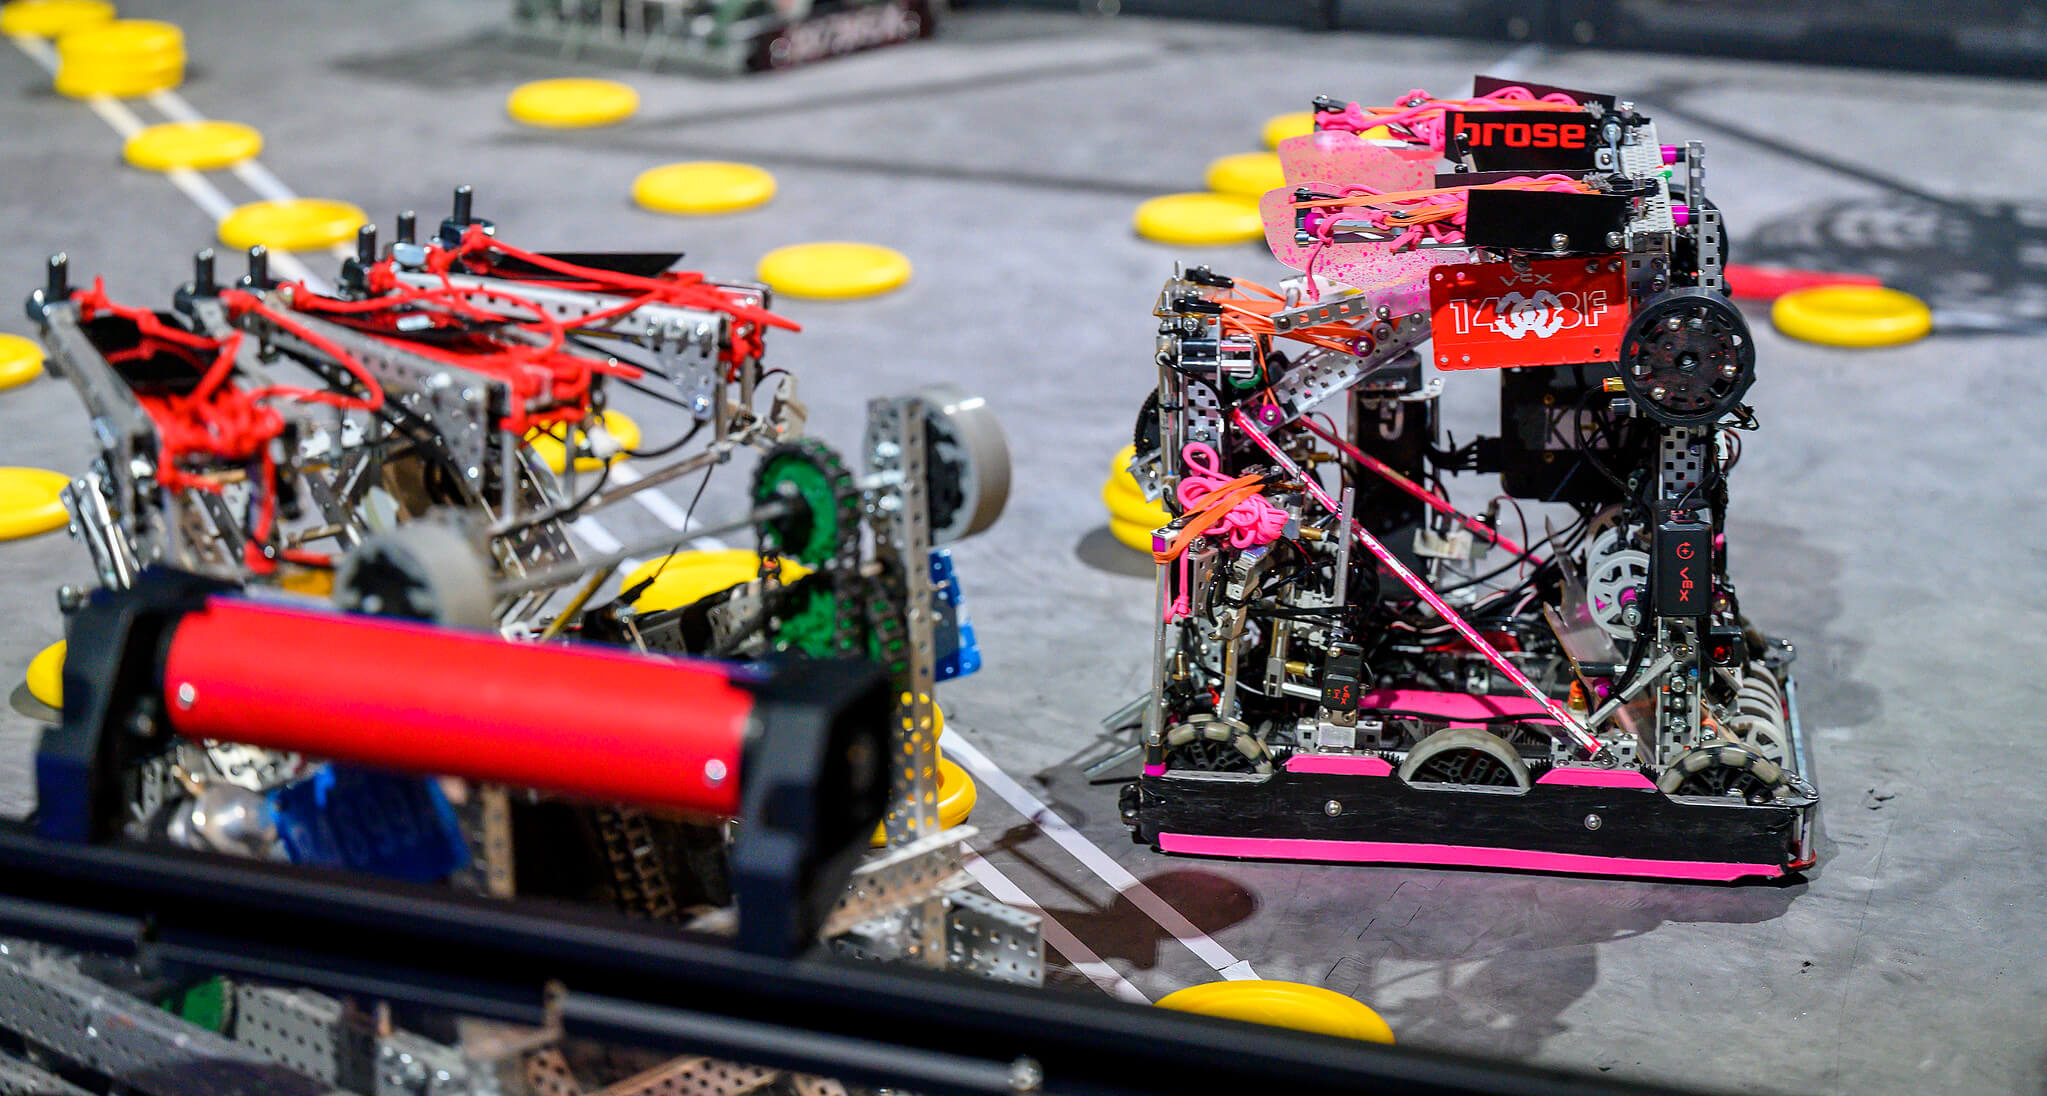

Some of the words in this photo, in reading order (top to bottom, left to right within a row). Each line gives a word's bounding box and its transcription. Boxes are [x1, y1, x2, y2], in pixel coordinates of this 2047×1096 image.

[1454, 113, 1586, 149] brose
[1500, 268, 1553, 287] VEX
[1680, 567, 1694, 602] VEX
